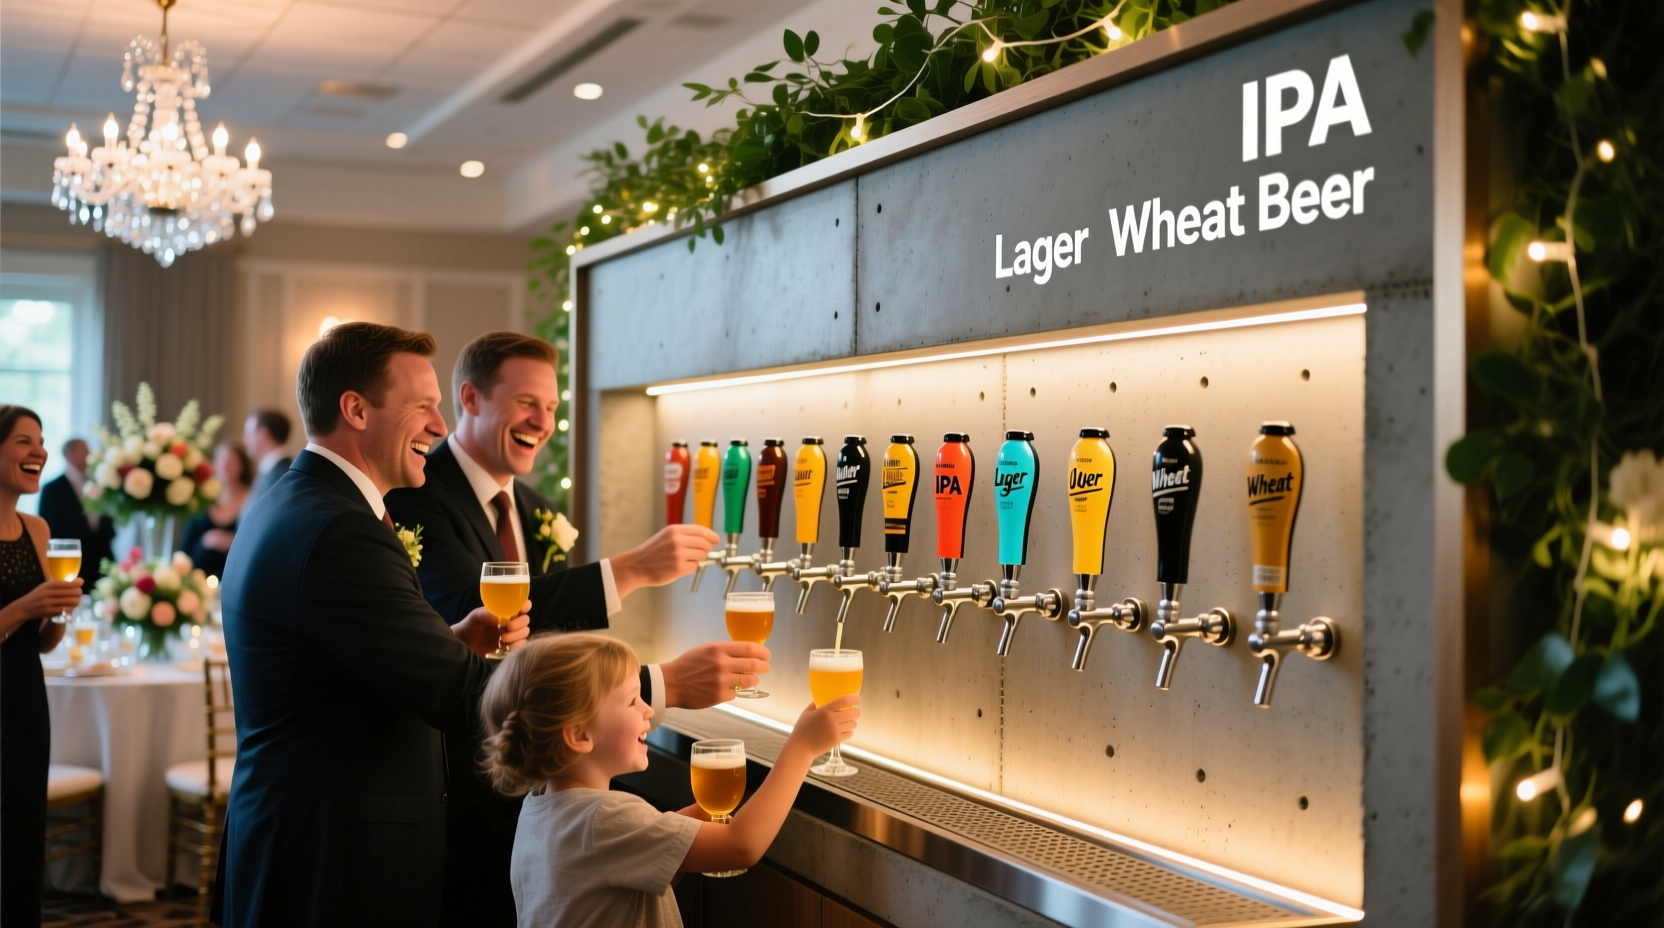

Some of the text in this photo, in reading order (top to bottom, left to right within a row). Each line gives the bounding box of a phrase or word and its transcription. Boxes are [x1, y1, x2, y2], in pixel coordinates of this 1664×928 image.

[1242, 53, 1372, 162] IPA
[995, 166, 1375, 285] Lager Wheat Beer
[936, 475, 962, 495] IPA
[1152, 464, 1191, 491] Wheat
[1247, 472, 1294, 498] Wheat
